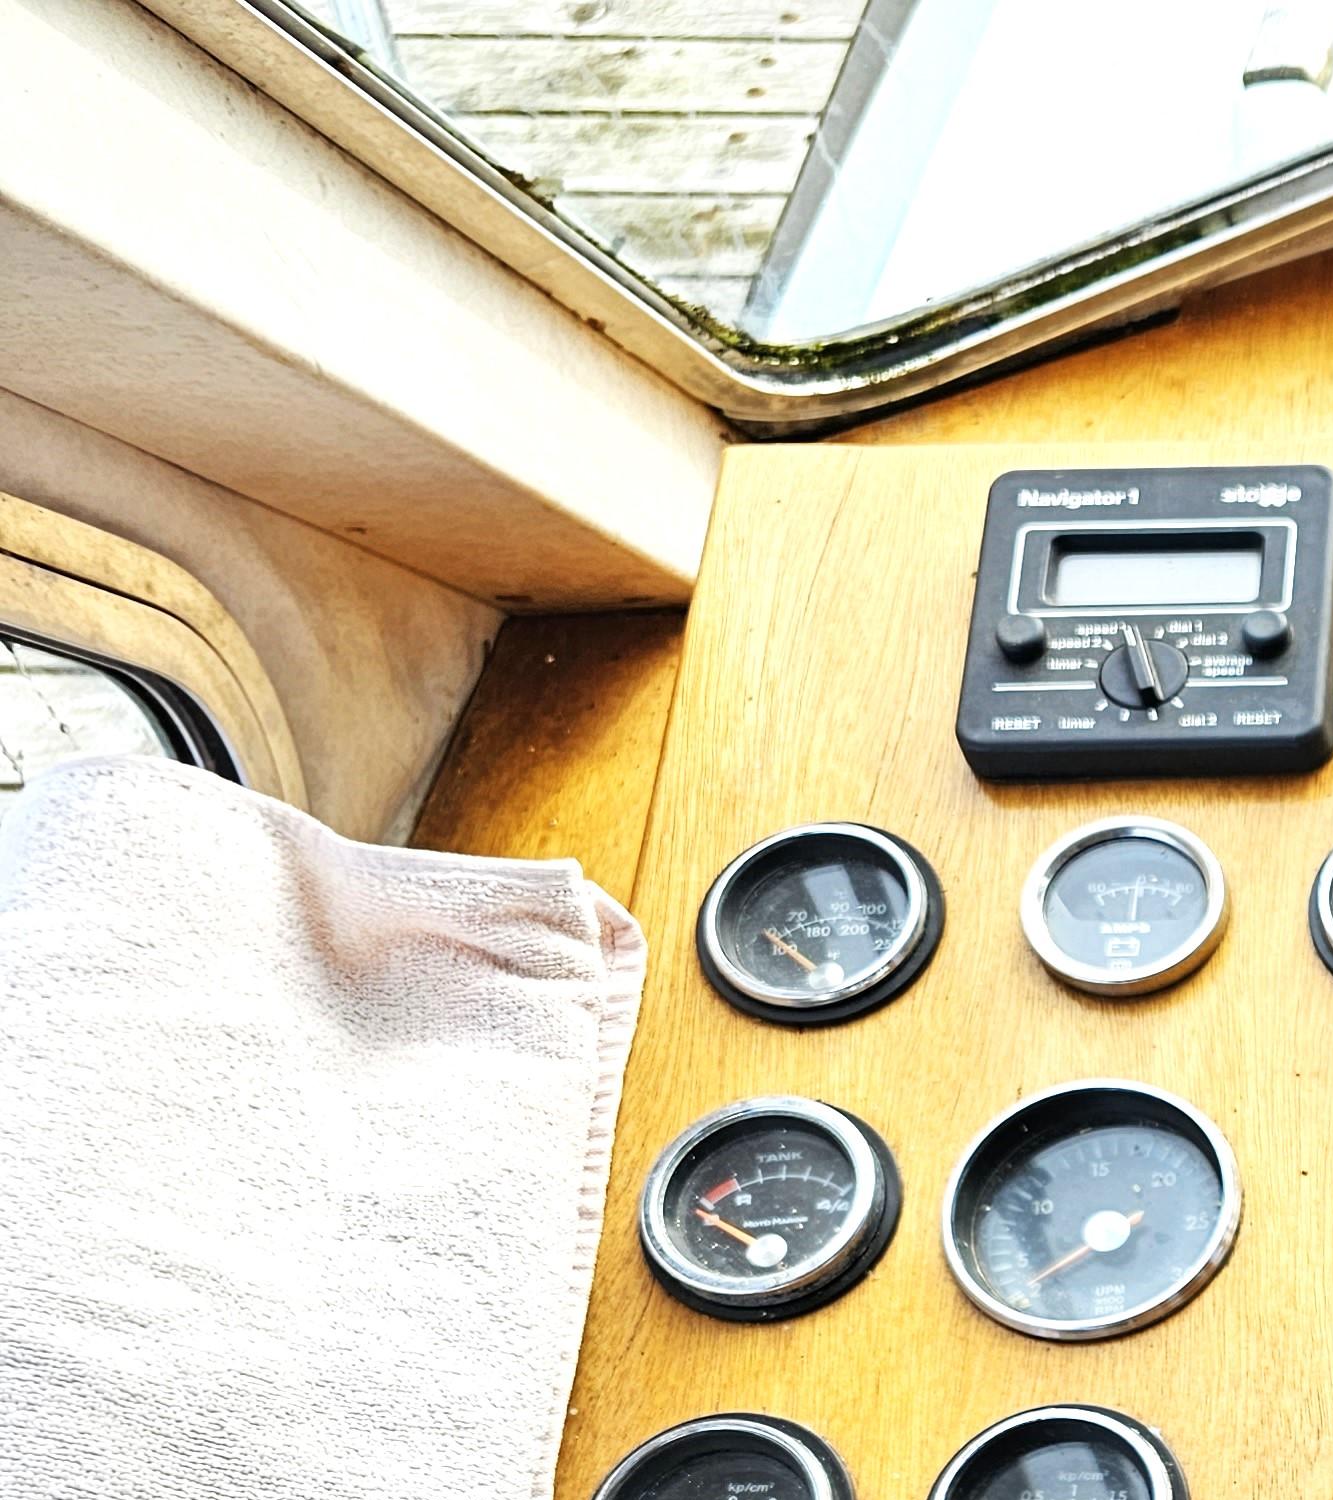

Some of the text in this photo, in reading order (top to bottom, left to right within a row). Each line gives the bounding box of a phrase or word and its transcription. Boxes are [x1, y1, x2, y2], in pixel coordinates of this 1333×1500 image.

[1018, 487, 1139, 509] Navigator 1
[806, 924, 870, 938] 180 200
[757, 1152, 803, 1163] TANK
[1151, 1172, 1176, 1187] 20
[1032, 1201, 1053, 1215] 10
